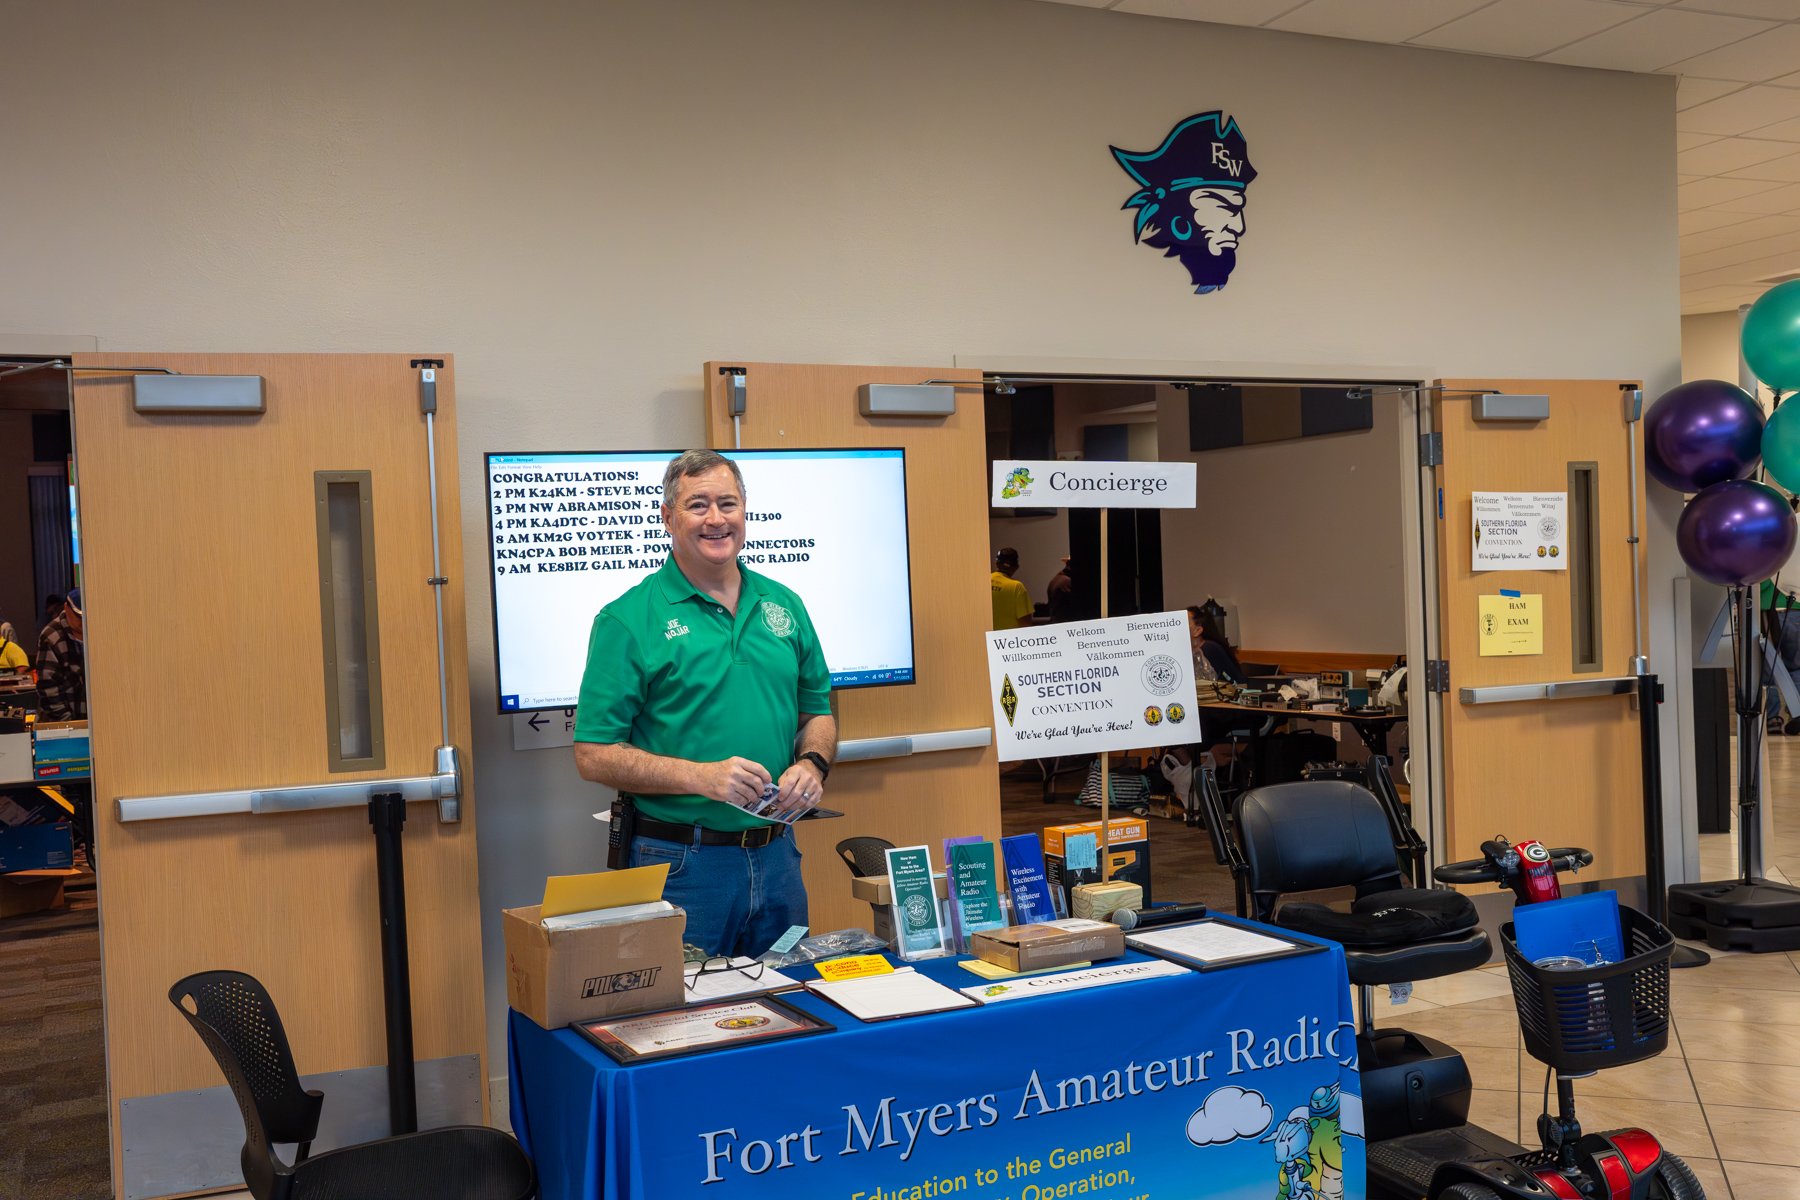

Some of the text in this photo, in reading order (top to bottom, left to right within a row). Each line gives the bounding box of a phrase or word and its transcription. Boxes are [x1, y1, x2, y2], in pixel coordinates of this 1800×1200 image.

[492, 471, 640, 484] CONGRATULATIONS!
[1050, 472, 1168, 496] Concierge
[493, 490, 502, 498] 2
[505, 488, 526, 498] PM
[587, 486, 632, 497] STEVE
[494, 506, 502, 515] 3
[506, 503, 526, 514] PM
[530, 503, 554, 513] NW
[557, 500, 642, 513] ABRAMISON
[495, 520, 503, 530] 4
[506, 518, 527, 528] PM
[530, 516, 588, 528] KA4DTC
[598, 515, 644, 526] DAVID
[496, 535, 504, 544] 8
[508, 534, 530, 543] AM
[533, 532, 572, 543] KM2G
[576, 530, 634, 541] VOYTEK
[497, 547, 555, 560] KN4CPA
[559, 546, 587, 557] BOB
[590, 544, 633, 555] MEIER
[497, 566, 505, 575] 9
[509, 563, 531, 574] AM
[538, 561, 588, 572] KE8BIZ
[592, 560, 625, 570] GAIL
[768, 552, 810, 563] RADIO
[1509, 602, 1526, 610] HAM
[667, 618, 681, 630] JOE
[1127, 618, 1182, 632] Bienvenido
[1508, 618, 1529, 626] EXAM
[1066, 626, 1106, 638] Welkom
[1144, 632, 1170, 643] Witaj
[993, 635, 1058, 651] Welcome
[1077, 637, 1130, 650] Benvenuto
[1002, 650, 1062, 663] Willkommen
[1086, 648, 1145, 662] Välkommen
[1018, 666, 1120, 686] SOUTHERN FLORIDA
[1038, 681, 1102, 698] SECTION
[1032, 699, 1113, 716] CONVENTION
[1015, 720, 1133, 740] We're Glad You're Here!
[1126, 825, 1140, 835] GUN
[959, 862, 986, 871] Scouting
[1011, 867, 1035, 876] Wireless
[959, 871, 971, 879] and
[1013, 874, 1044, 885] Excitement
[960, 880, 987, 888] Amateur
[1015, 885, 1028, 893] with
[961, 888, 980, 896] Radio
[1017, 892, 1040, 901] Amateur
[1018, 902, 1036, 910] Radio
[1028, 966, 1151, 987] Concierge
[691, 1009, 728, 1019] Service
[698, 1125, 822, 1185] Fort
[839, 1094, 999, 1162] Myers
[1013, 1049, 1215, 1120] Amateur
[975, 1169, 999, 1187] to
[1006, 1156, 1042, 1181] the
[1049, 1132, 1131, 1170] General
[1021, 1169, 1136, 1200] Operation,
